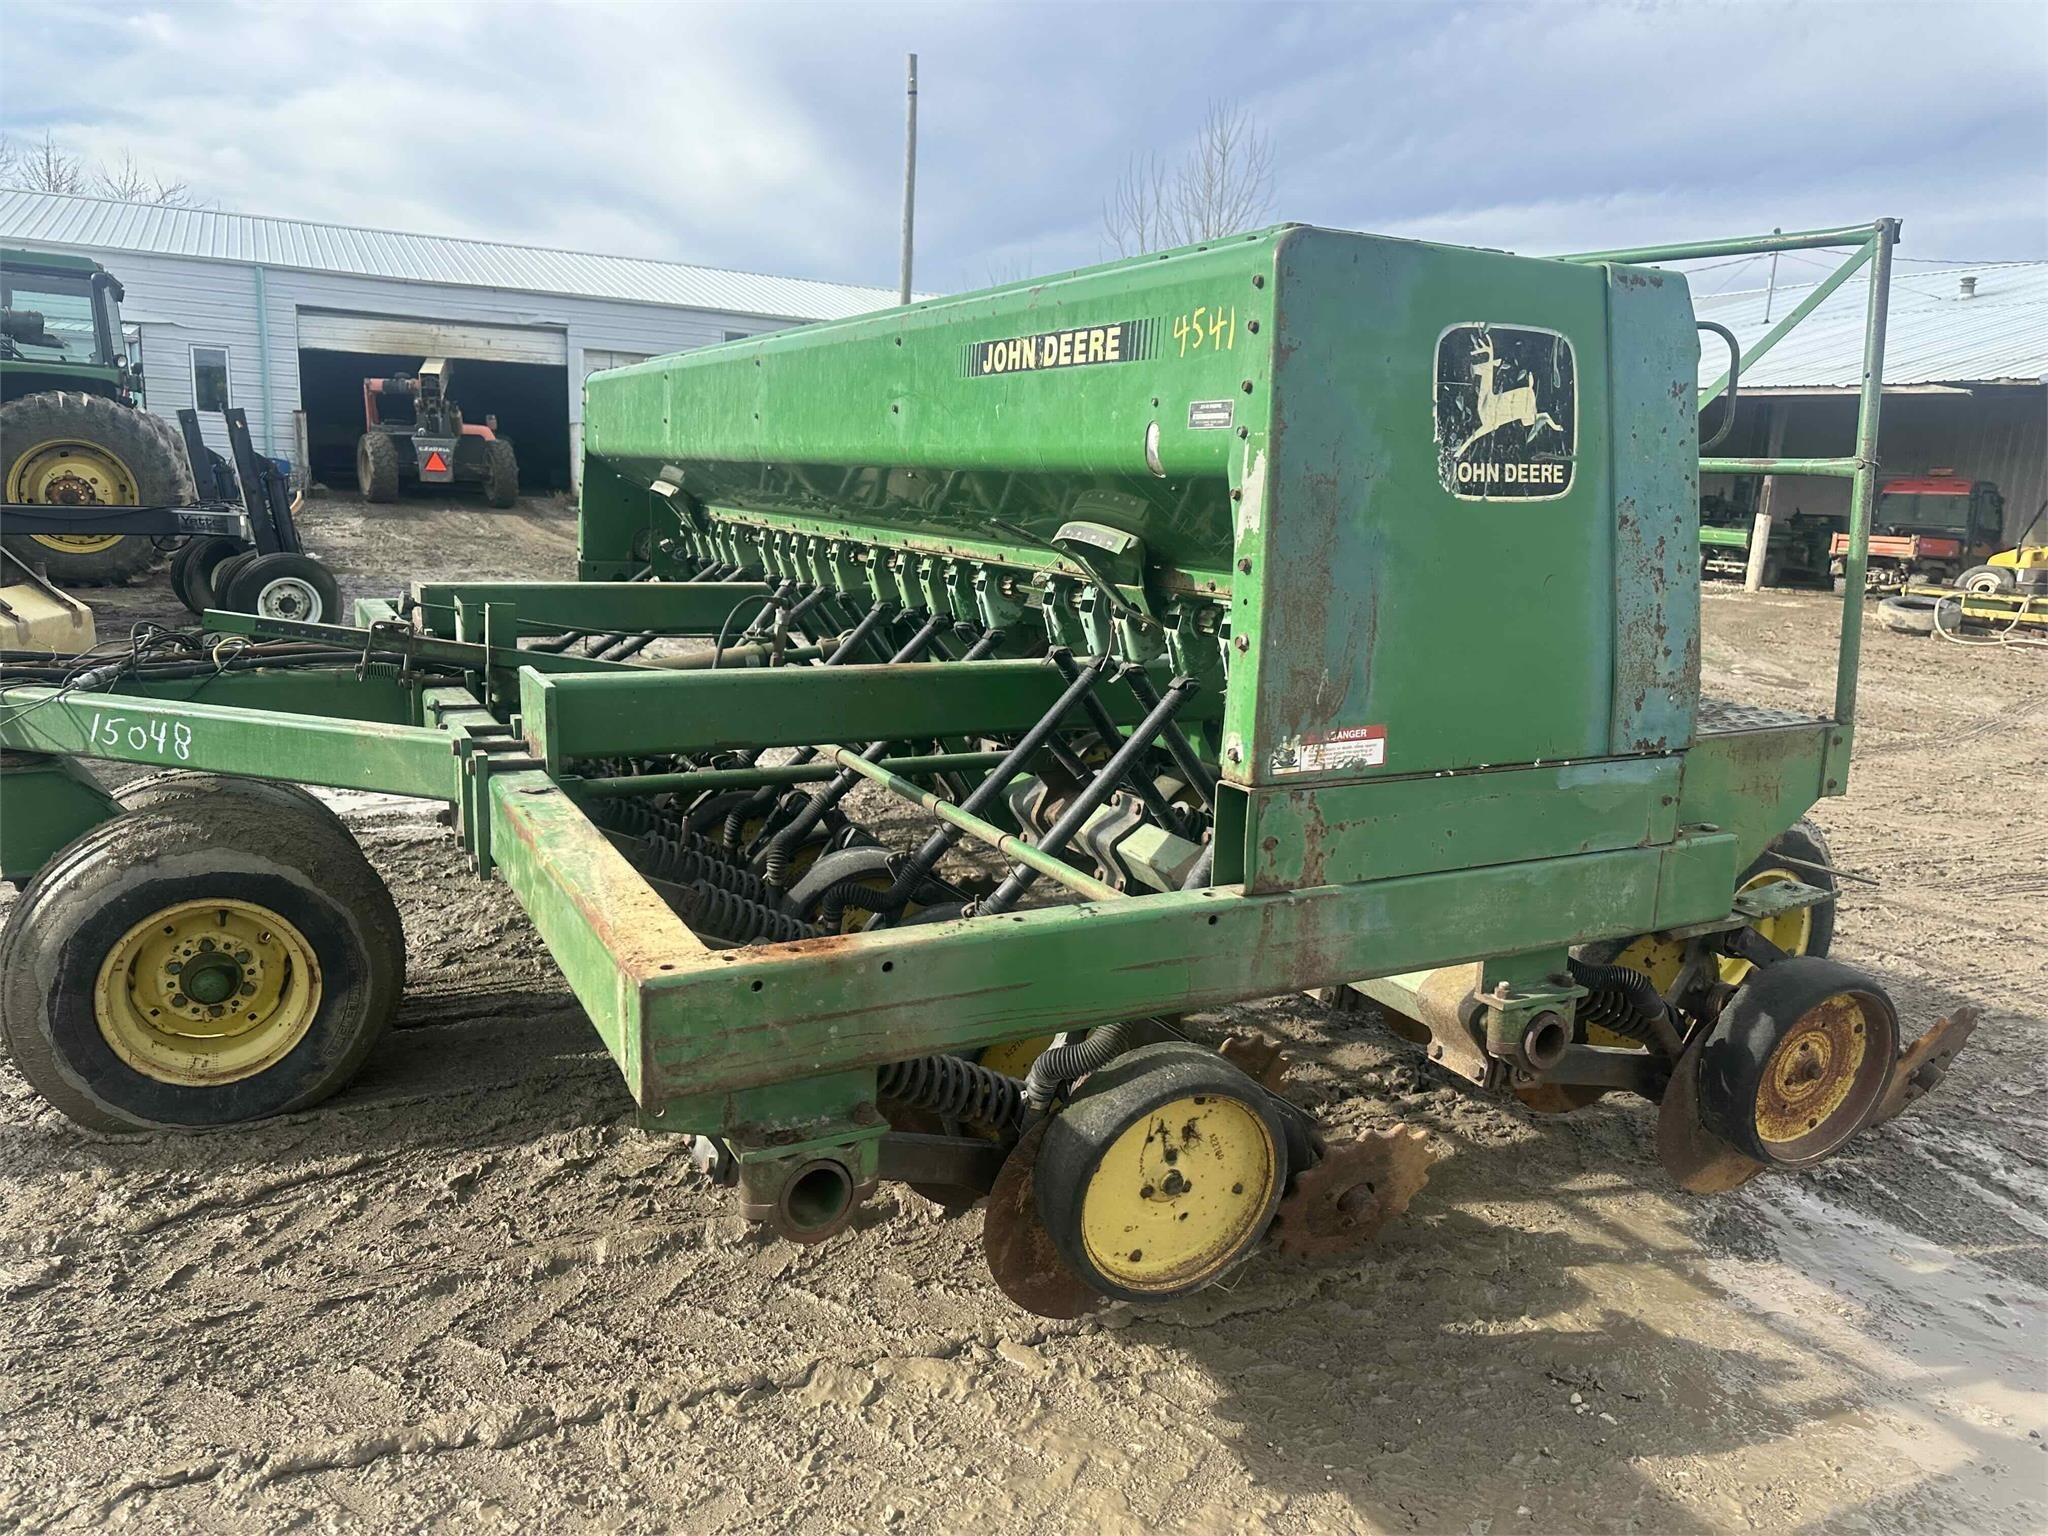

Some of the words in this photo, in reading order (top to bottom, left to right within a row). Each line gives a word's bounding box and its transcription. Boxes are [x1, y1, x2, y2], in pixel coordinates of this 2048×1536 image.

[982, 336, 1037, 374] JOHN
[1042, 325, 1122, 368] DEERE
[1173, 305, 1236, 358] 4541
[1504, 462, 1565, 484] DEERE
[90, 713, 192, 760] 15048
